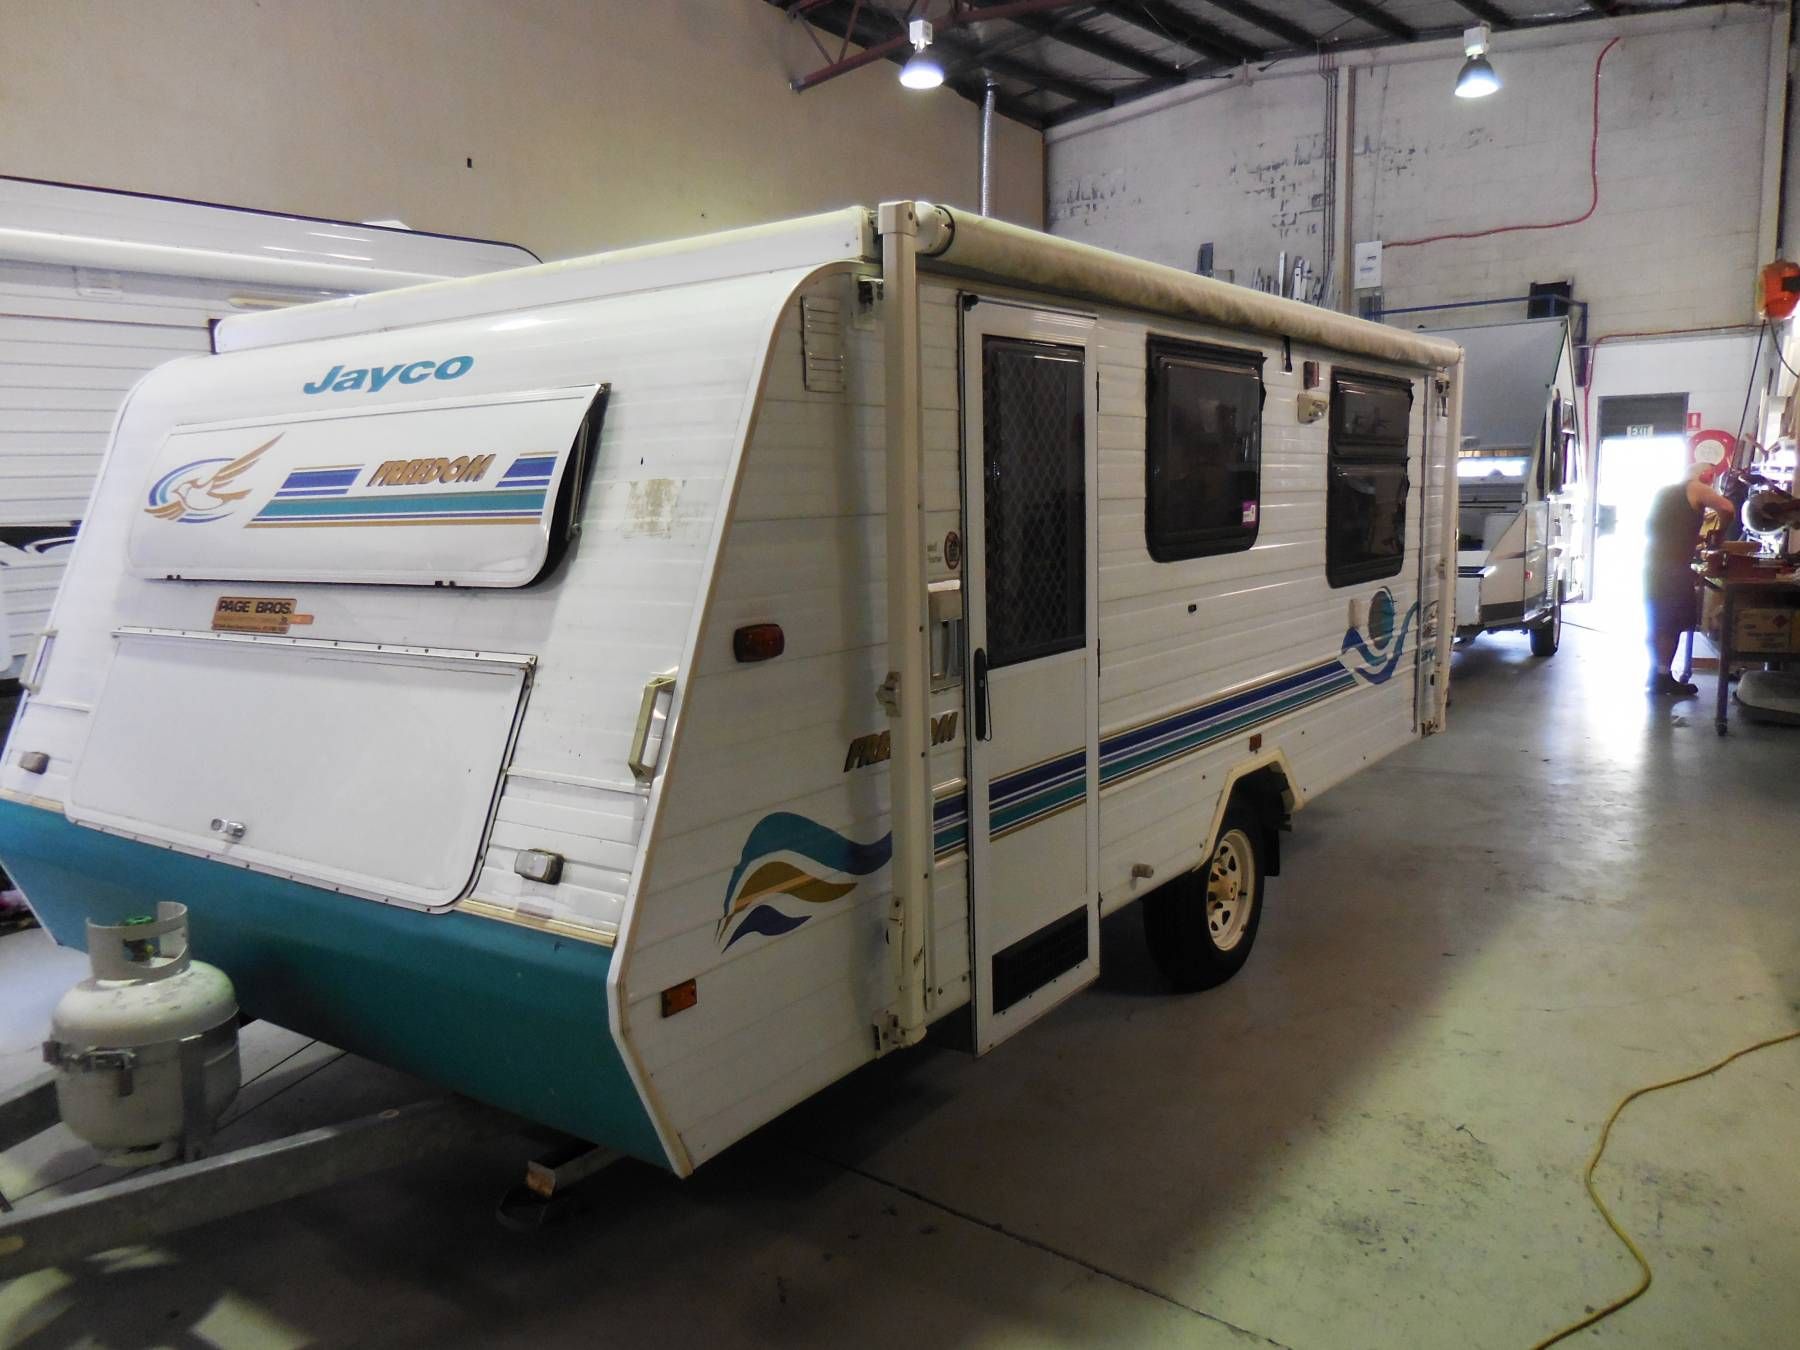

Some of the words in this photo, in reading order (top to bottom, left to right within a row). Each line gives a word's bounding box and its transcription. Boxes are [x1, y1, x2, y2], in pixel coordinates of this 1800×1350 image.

[303, 355, 474, 395] Jayco
[1631, 425, 1650, 437] EXIT
[366, 453, 497, 487] FREEDOM
[218, 600, 252, 613] PAGE
[255, 601, 292, 614] BROS.
